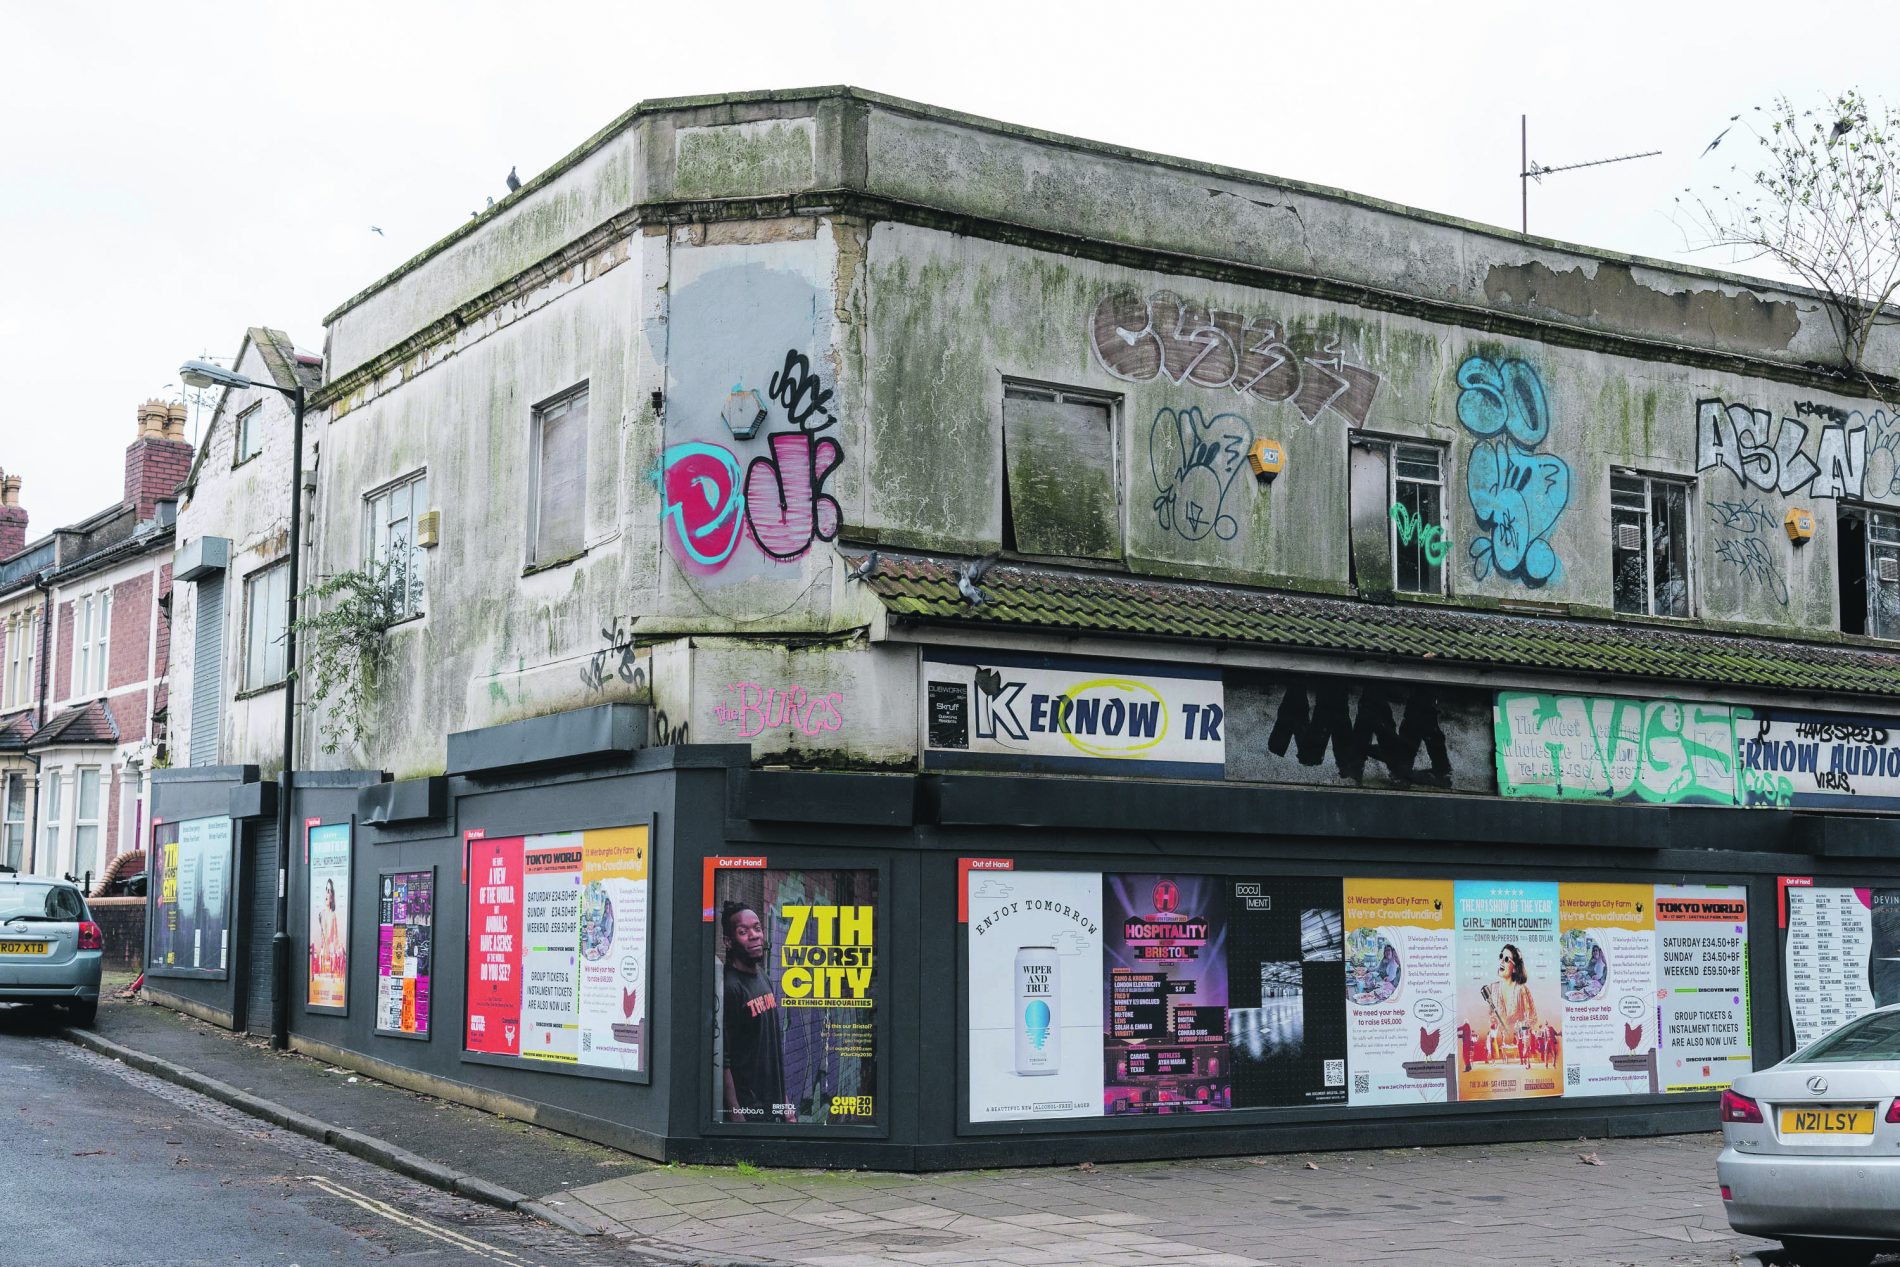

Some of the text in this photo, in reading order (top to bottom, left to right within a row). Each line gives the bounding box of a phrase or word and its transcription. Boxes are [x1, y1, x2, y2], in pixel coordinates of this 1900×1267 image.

[974, 680, 1161, 741] KERNOW
[526, 852, 582, 865] TOKYO WORLD
[719, 859, 762, 867] Out of Hand
[1237, 886, 1259, 895] DOCU
[528, 892, 551, 902] SATURDAY
[1347, 896, 1429, 905] St Werburghs City Farm
[1248, 899, 1268, 907] MENT
[1560, 900, 1632, 908] St Werburghs City Farm
[528, 907, 546, 918] SUNDAY
[1658, 903, 1744, 914] TOKYO WORLD
[976, 900, 1097, 935] ENJOY TOMORROW
[527, 922, 549, 932] WEEKEND
[782, 906, 872, 945] 7TH
[1462, 918, 1552, 928] GIRL NORTH COUNTRY
[1125, 925, 1207, 938] HOSPITALITY
[1664, 938, 1740, 948] SATURDAY £34.50+BF
[784, 947, 872, 966] WORST
[1145, 947, 1188, 958] BRISTOL
[1664, 952, 1740, 962] SUNDAY £34.50+BF
[1023, 966, 1052, 974] WIPER
[1664, 966, 1740, 976] WEEKEND £59.50+BF
[530, 972, 568, 982] GROUP TICKETS &
[1028, 975, 1048, 983] AND
[782, 968, 872, 998] CITY
[527, 986, 572, 997] INSTALMENT TICKETS
[1026, 984, 1049, 993] TRUE
[528, 1000, 571, 1011] ARE ALSO NOW LIVE
[782, 999, 796, 1007] FOR
[798, 999, 824, 1007] ETHNIC
[825, 999, 872, 1007] INEQUALITIES
[1353, 1009, 1405, 1018] We need your help
[1565, 1006, 1612, 1014] We need your help
[1674, 1011, 1732, 1020] GROUP TICKETS &
[1669, 1024, 1738, 1034] INSTALMENT TICKETS
[1672, 1037, 1736, 1046] ARE ALSO NOW LIVE
[832, 1097, 871, 1105] OUR 20
[830, 1106, 871, 1115] CITY 30
[1795, 1112, 1858, 1131] N21 LSY
